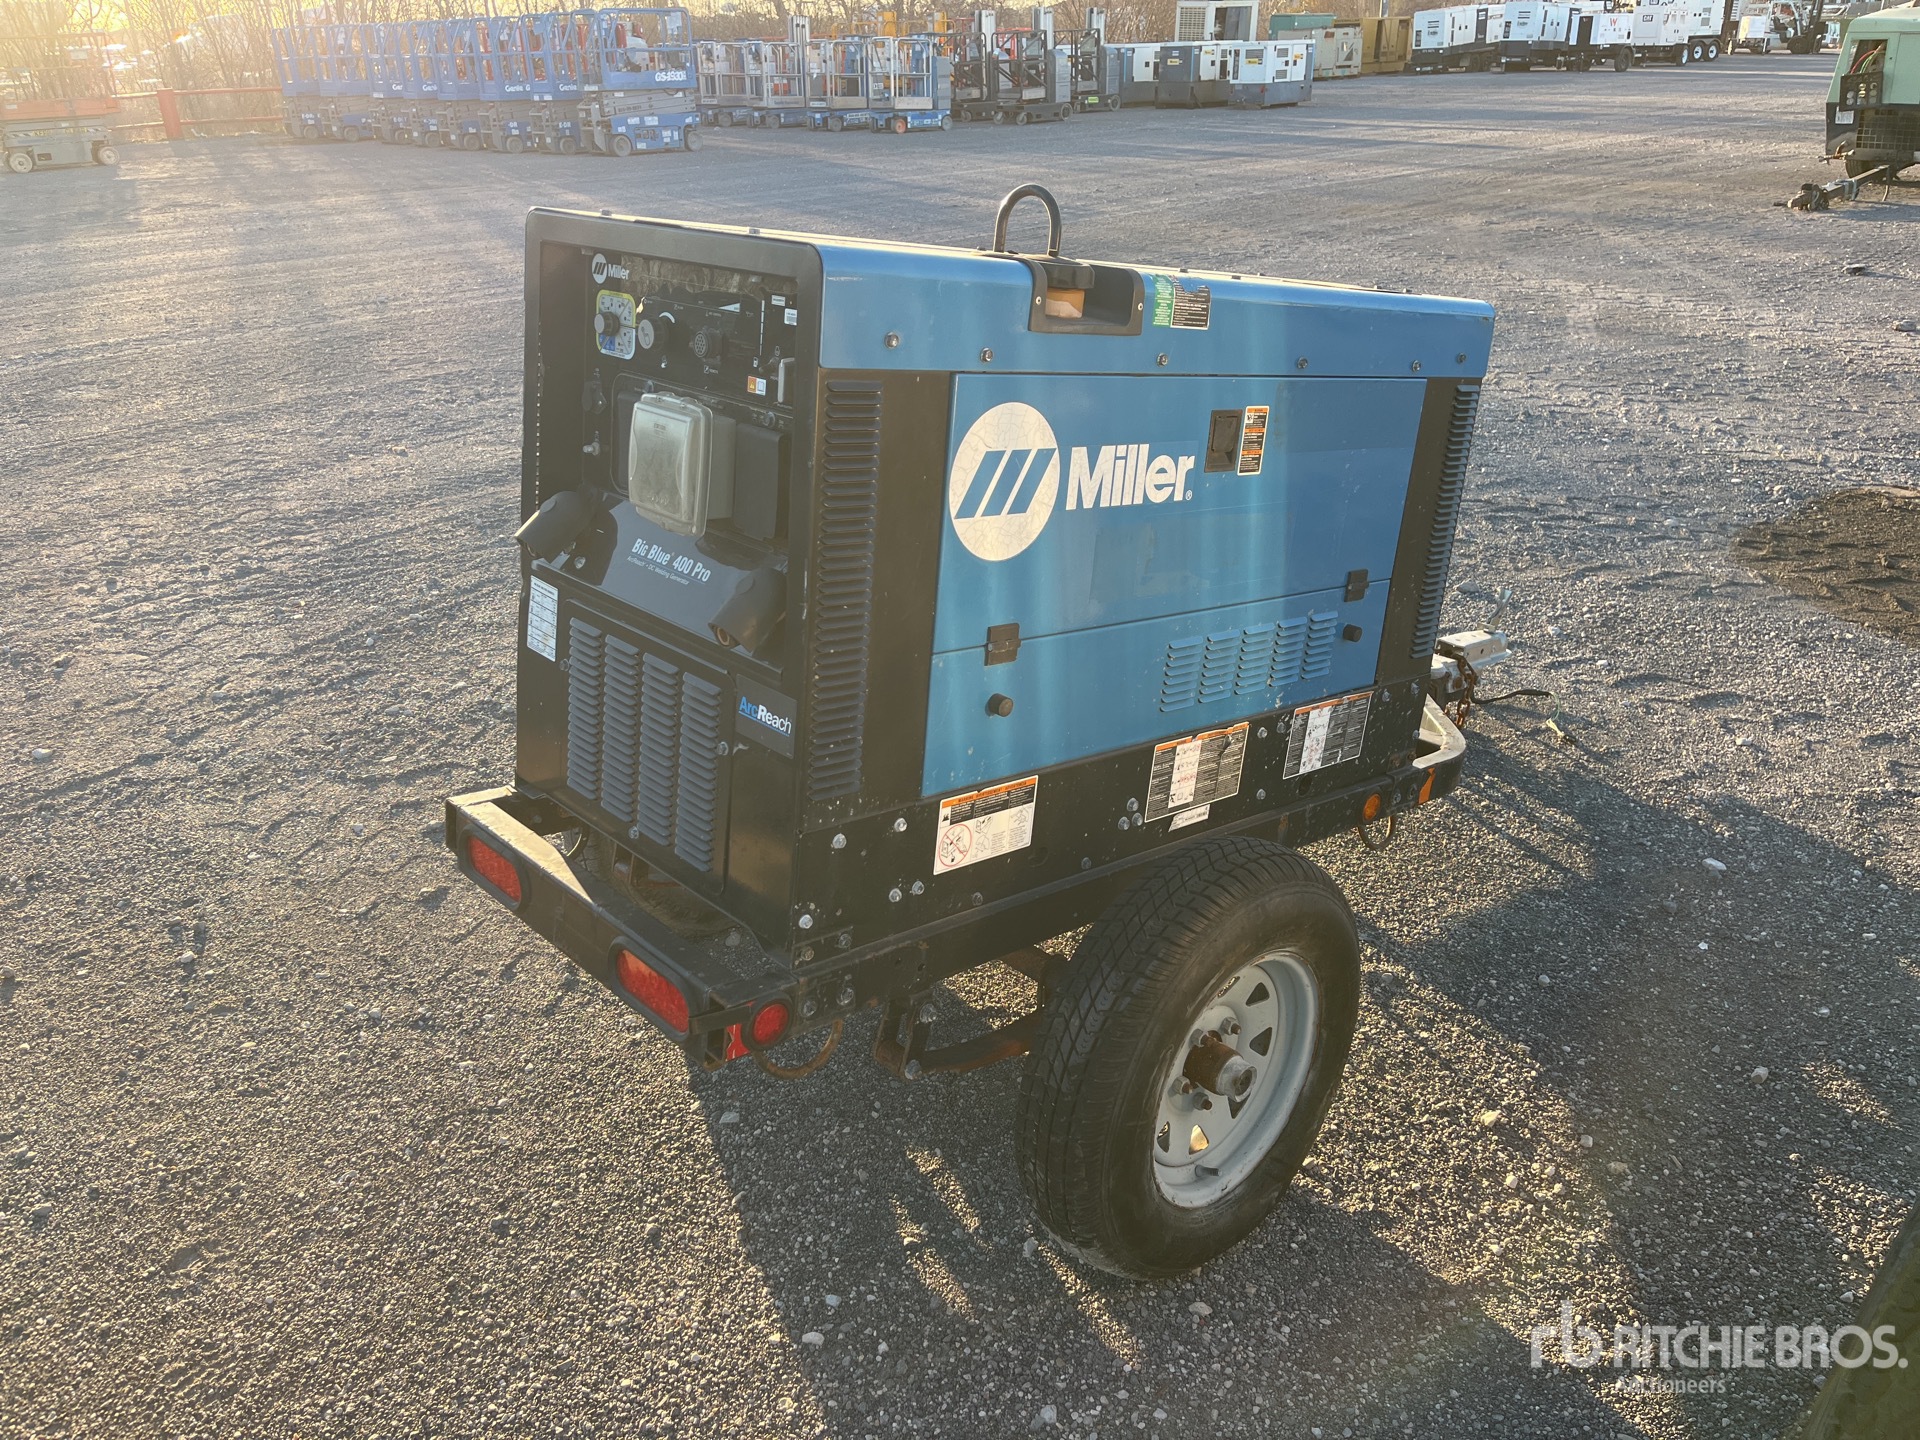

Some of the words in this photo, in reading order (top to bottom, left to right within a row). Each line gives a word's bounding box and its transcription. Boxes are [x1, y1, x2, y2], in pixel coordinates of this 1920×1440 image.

[607, 264, 630, 280] Miller
[632, 538, 649, 557] Big
[672, 555, 694, 575] 400
[691, 562, 711, 582] Pro
[739, 696, 792, 734] ArcReach
